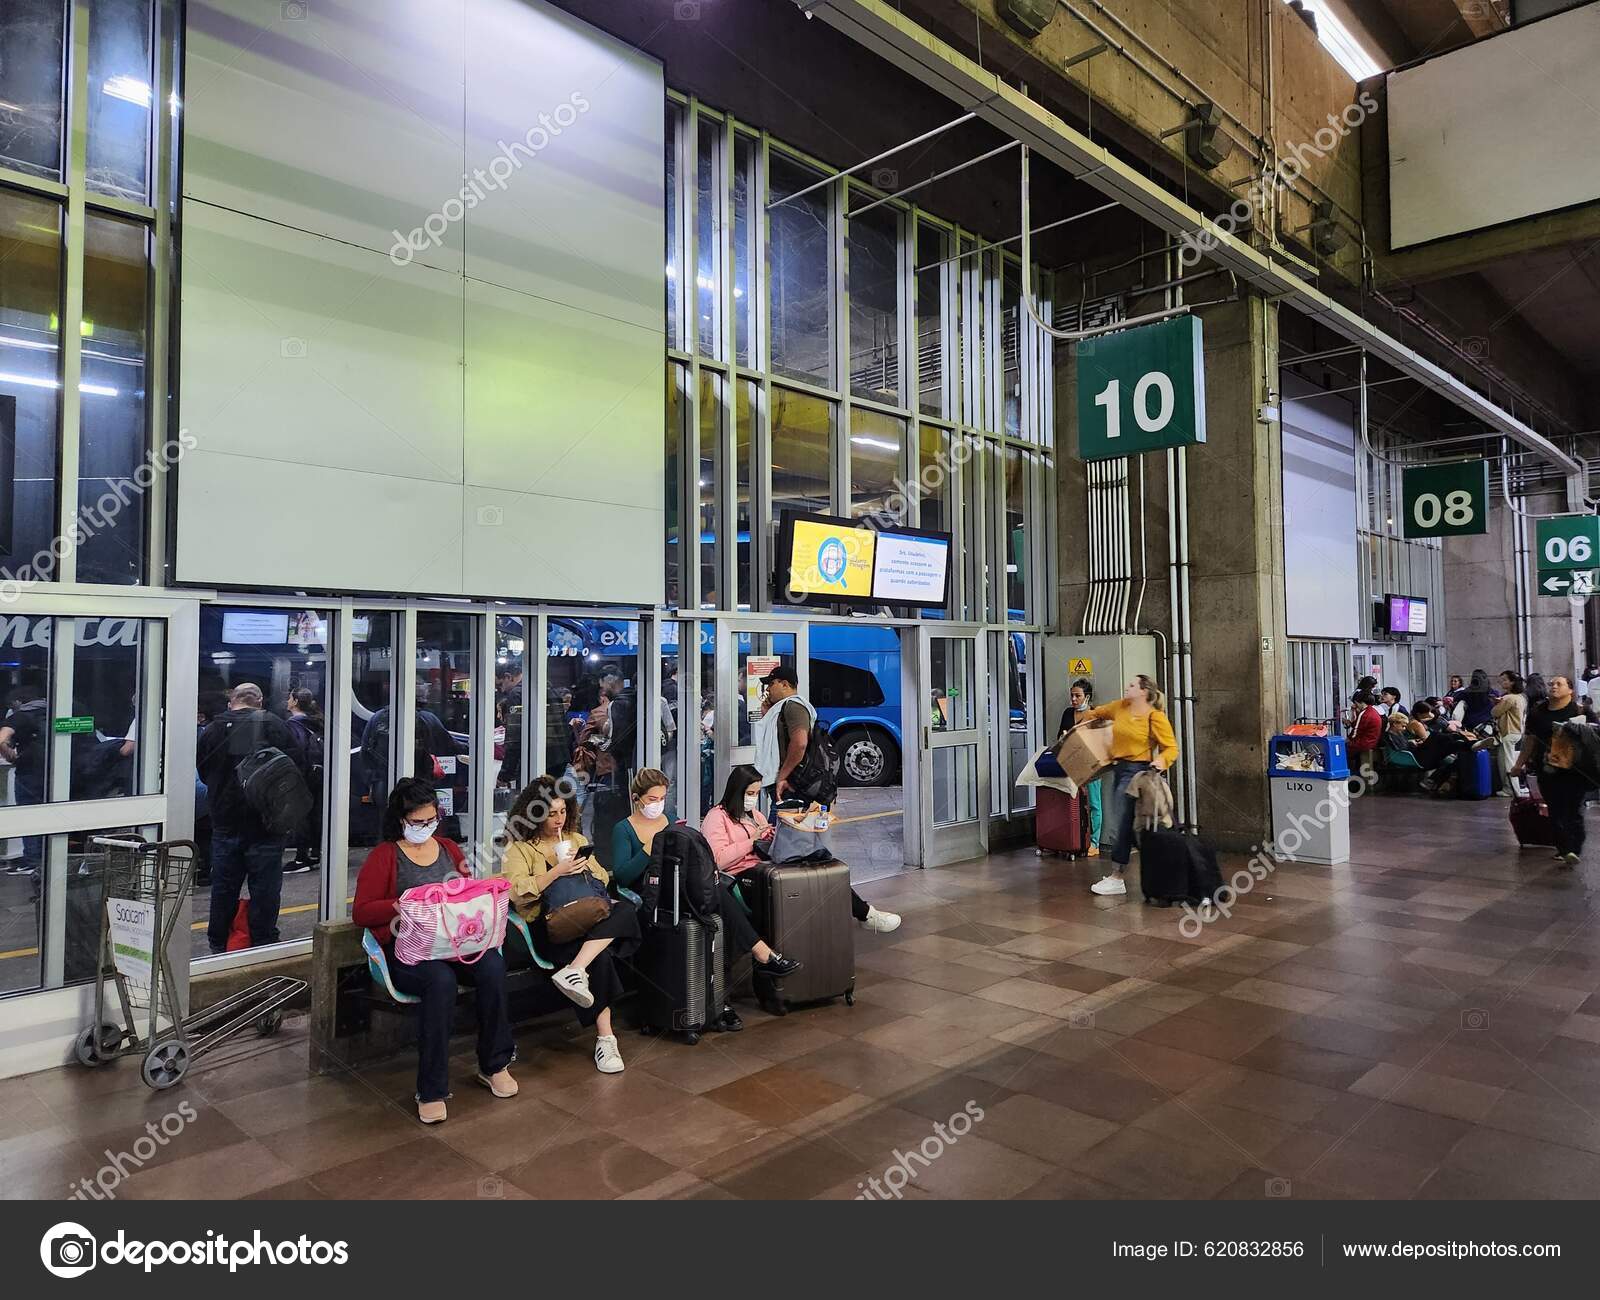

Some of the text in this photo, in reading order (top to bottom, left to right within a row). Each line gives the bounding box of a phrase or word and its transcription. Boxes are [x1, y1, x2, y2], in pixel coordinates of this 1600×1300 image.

[1095, 371, 1175, 438] 10
[1414, 490, 1474, 528] 08
[1545, 535, 1592, 563] 06
[1287, 782, 1313, 792] LIXO
[115, 903, 146, 926] Socicam
